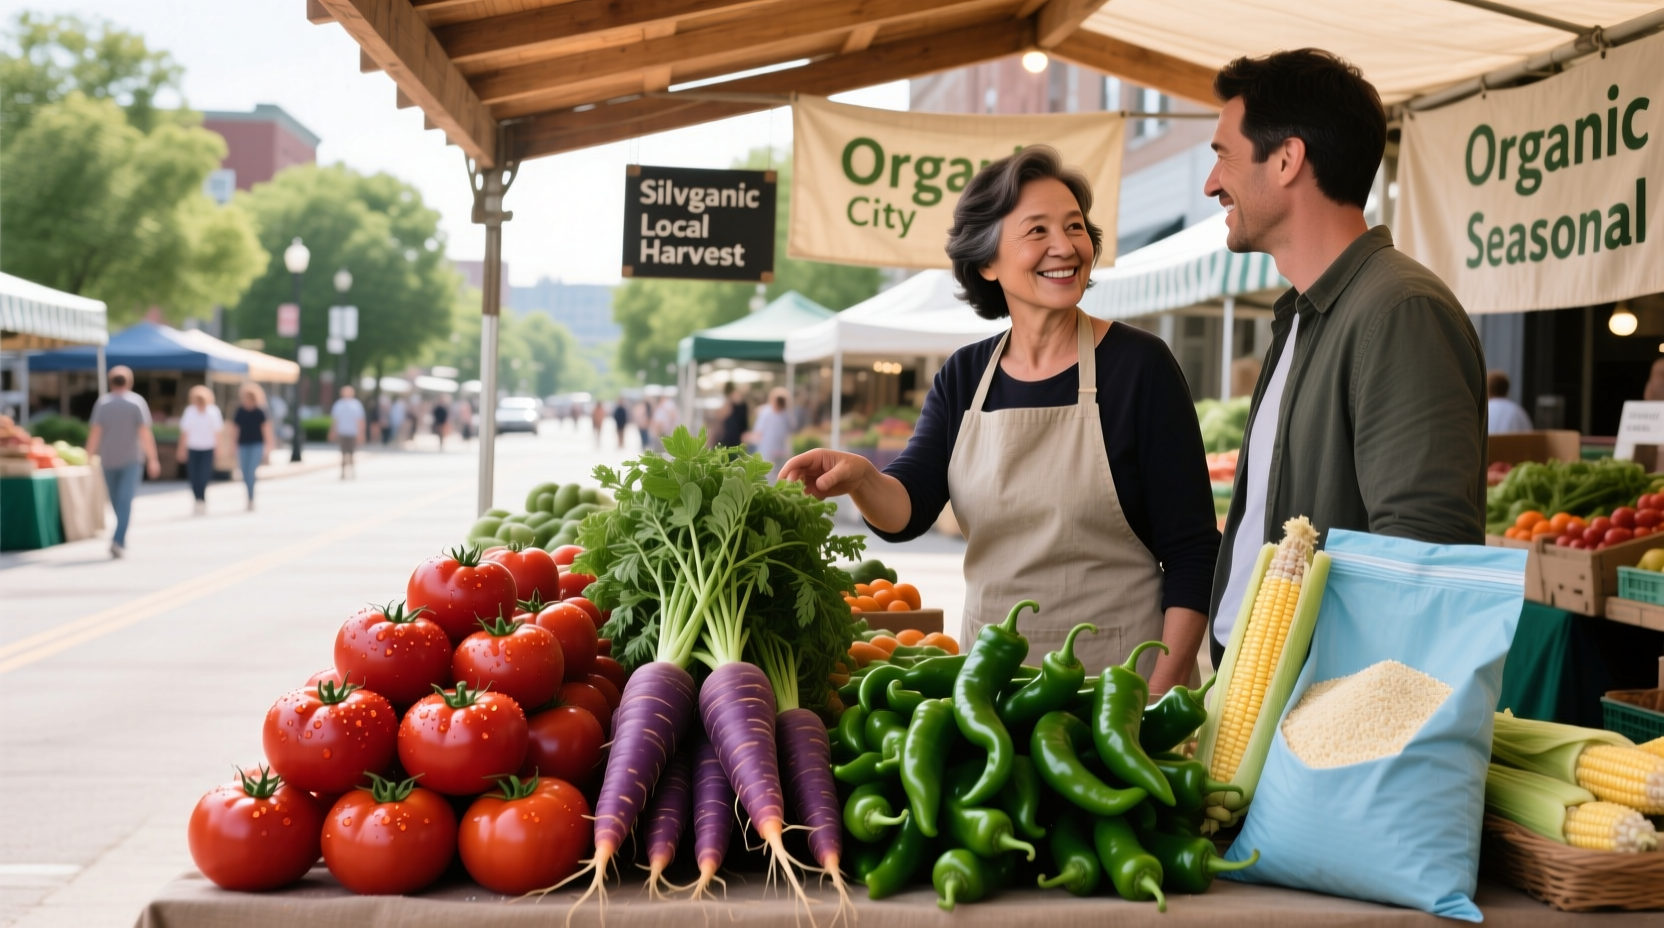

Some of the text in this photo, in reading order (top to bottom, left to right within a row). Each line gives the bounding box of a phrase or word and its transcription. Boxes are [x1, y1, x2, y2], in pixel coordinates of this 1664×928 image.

[1465, 84, 1650, 196] Organic
[841, 137, 1023, 207] Orga
[639, 179, 760, 214] Silvganic
[641, 213, 709, 238] Local
[847, 197, 916, 239] City
[1466, 177, 1646, 269] Seasonal
[640, 239, 745, 267] Harvest
